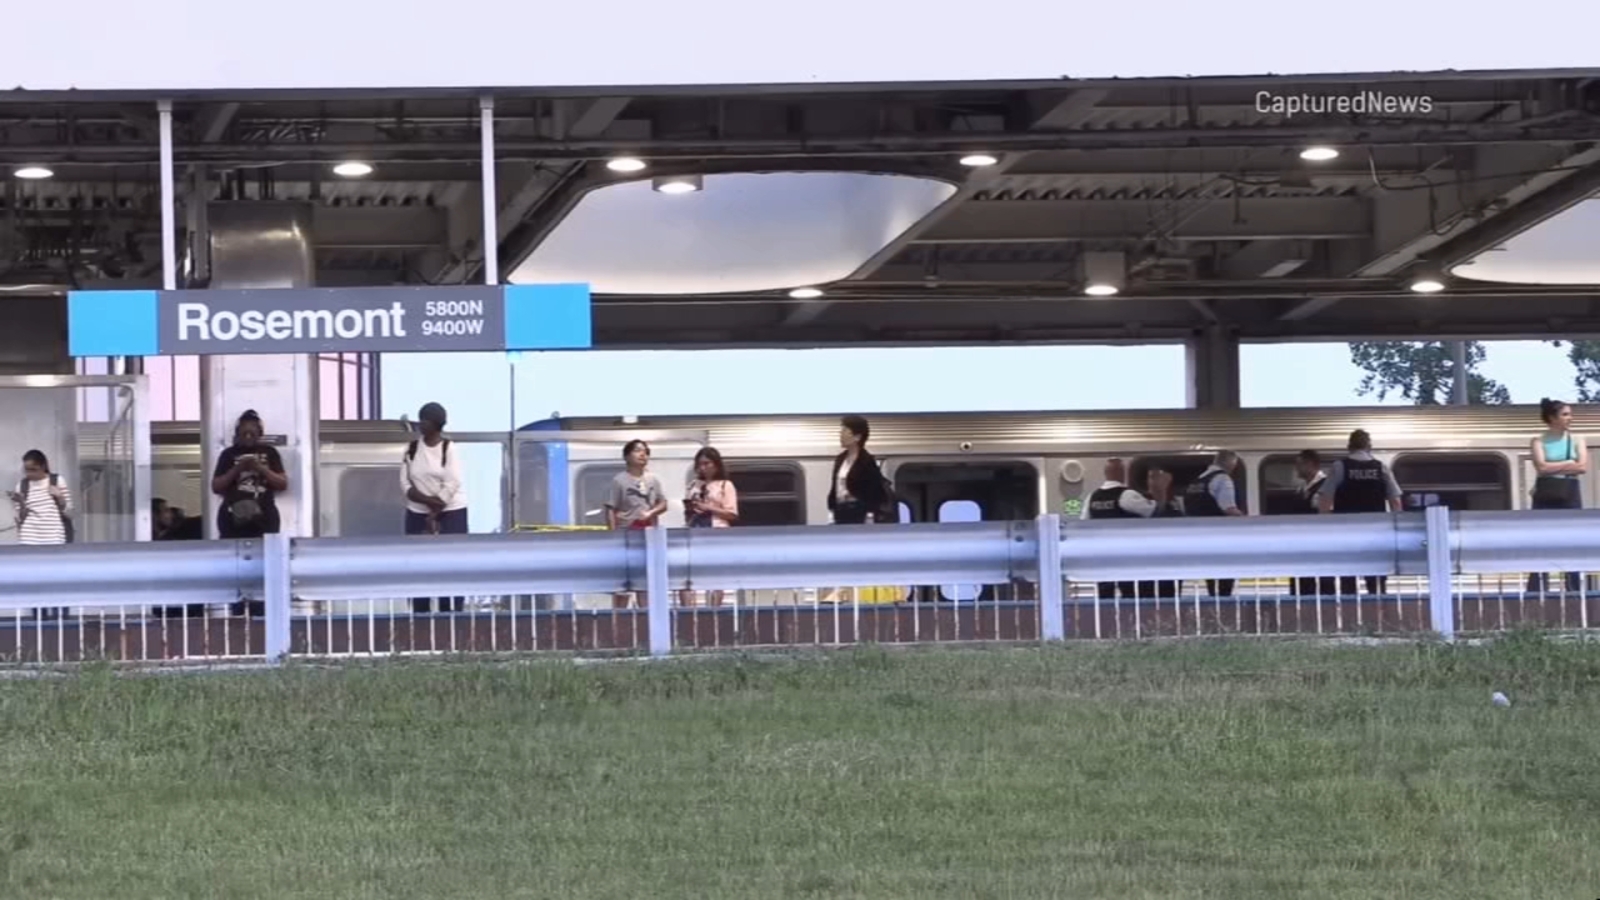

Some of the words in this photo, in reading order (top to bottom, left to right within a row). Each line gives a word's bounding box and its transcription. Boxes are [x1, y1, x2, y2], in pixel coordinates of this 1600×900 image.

[425, 300, 484, 316] 5800N
[178, 301, 406, 340] Rosemont
[421, 318, 484, 336] 9400W
[1348, 469, 1381, 479] POLICE
